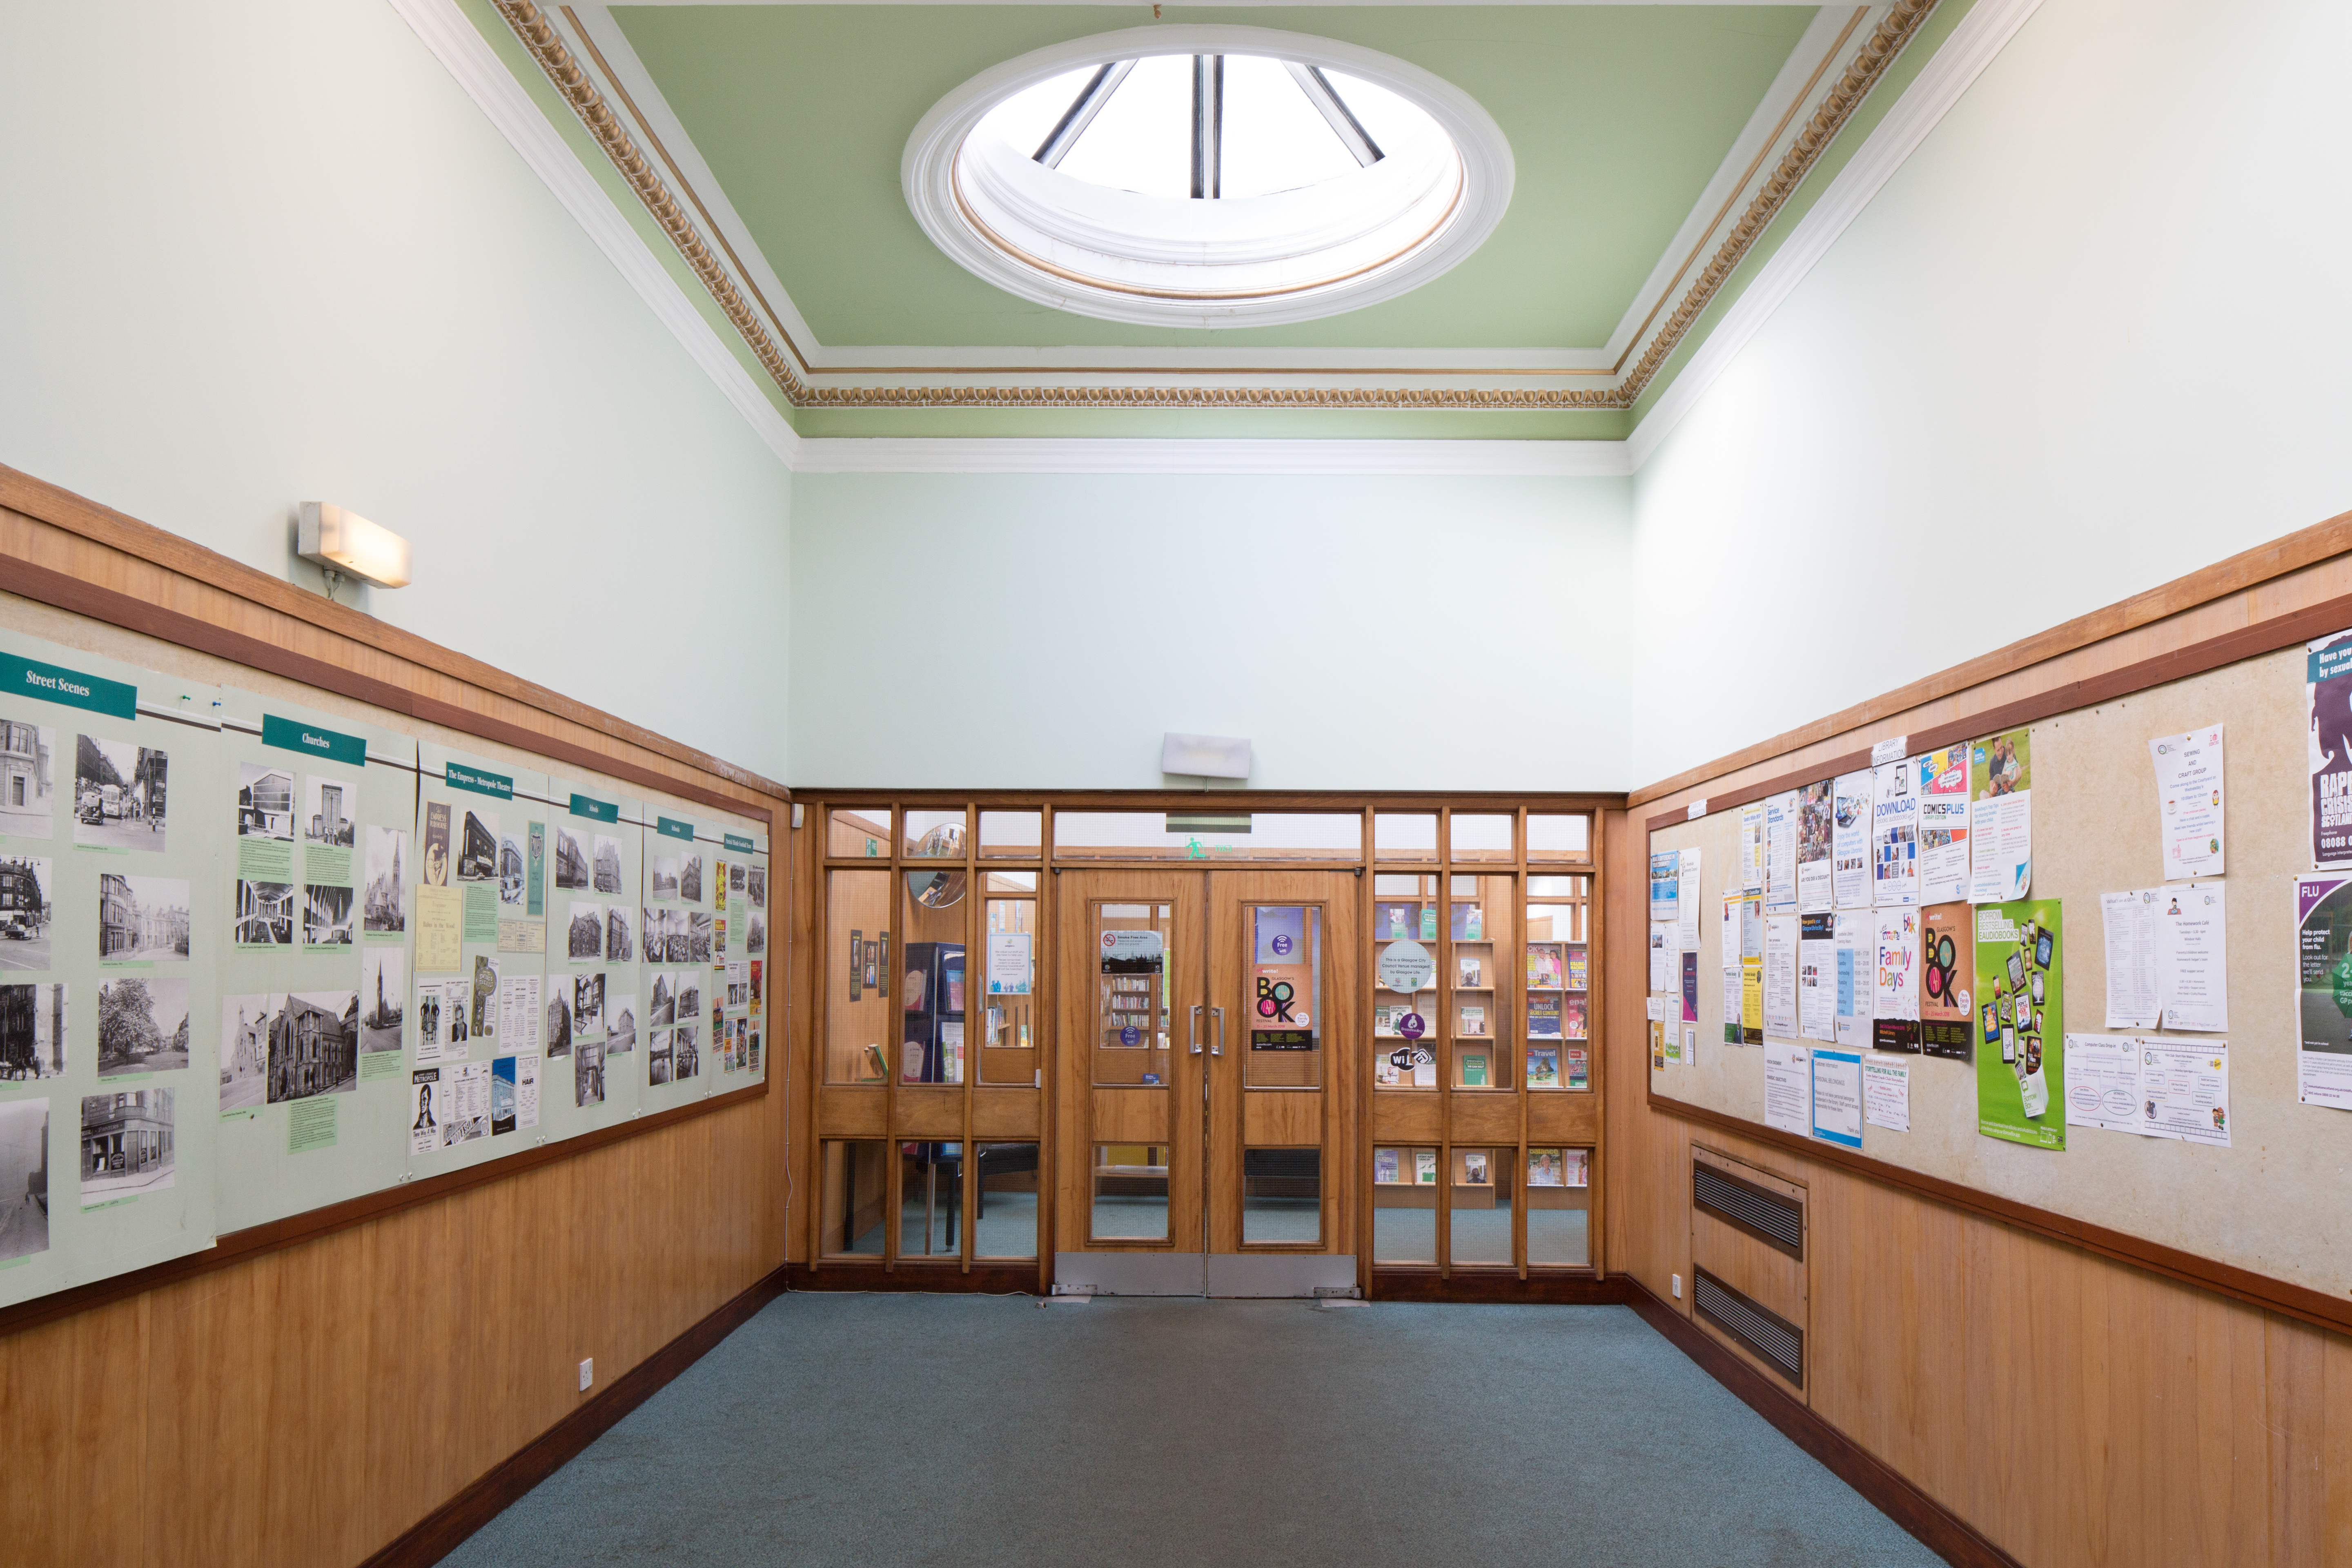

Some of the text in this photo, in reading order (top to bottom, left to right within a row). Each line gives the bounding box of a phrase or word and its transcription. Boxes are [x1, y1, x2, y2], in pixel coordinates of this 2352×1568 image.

[2319, 647, 2352, 664] Have you
[2319, 657, 2352, 678] by sexual
[26, 670, 89, 697] Street Scenes
[302, 732, 330, 749] Churches
[1878, 738, 1899, 751] LIBRARY
[1873, 748, 1905, 765] INFORMATION
[2184, 749, 2200, 757] SEWING
[448, 769, 457, 779] The
[457, 771, 474, 784] Empress
[477, 777, 496, 790] Metropole
[497, 781, 510, 792] Theatre
[589, 804, 599, 813] Schools
[1877, 798, 1915, 817] DOWNLOAD
[1924, 804, 1964, 814] COMICSPLUS
[2321, 795, 2352, 815] CRISIS
[1768, 808, 1779, 816] Service
[1889, 813, 1907, 822] audiobooks
[1767, 815, 1784, 824] Standards
[671, 824, 680, 833] Schools
[2321, 836, 2346, 849] 08088
[2302, 886, 2319, 898] FLU
[1979, 911, 2001, 920] BORROW
[1979, 920, 2013, 930] BESTSELLING
[1883, 932, 1900, 940] write!
[1979, 930, 2018, 939] EAUDIOBOOKS
[1880, 946, 1911, 971] Family
[1880, 967, 1904, 992] Days
[1393, 1056, 1405, 1064] Wi
[414, 1072, 437, 1083] METROPOLE
[2023, 1093, 2037, 1102] Borrow
